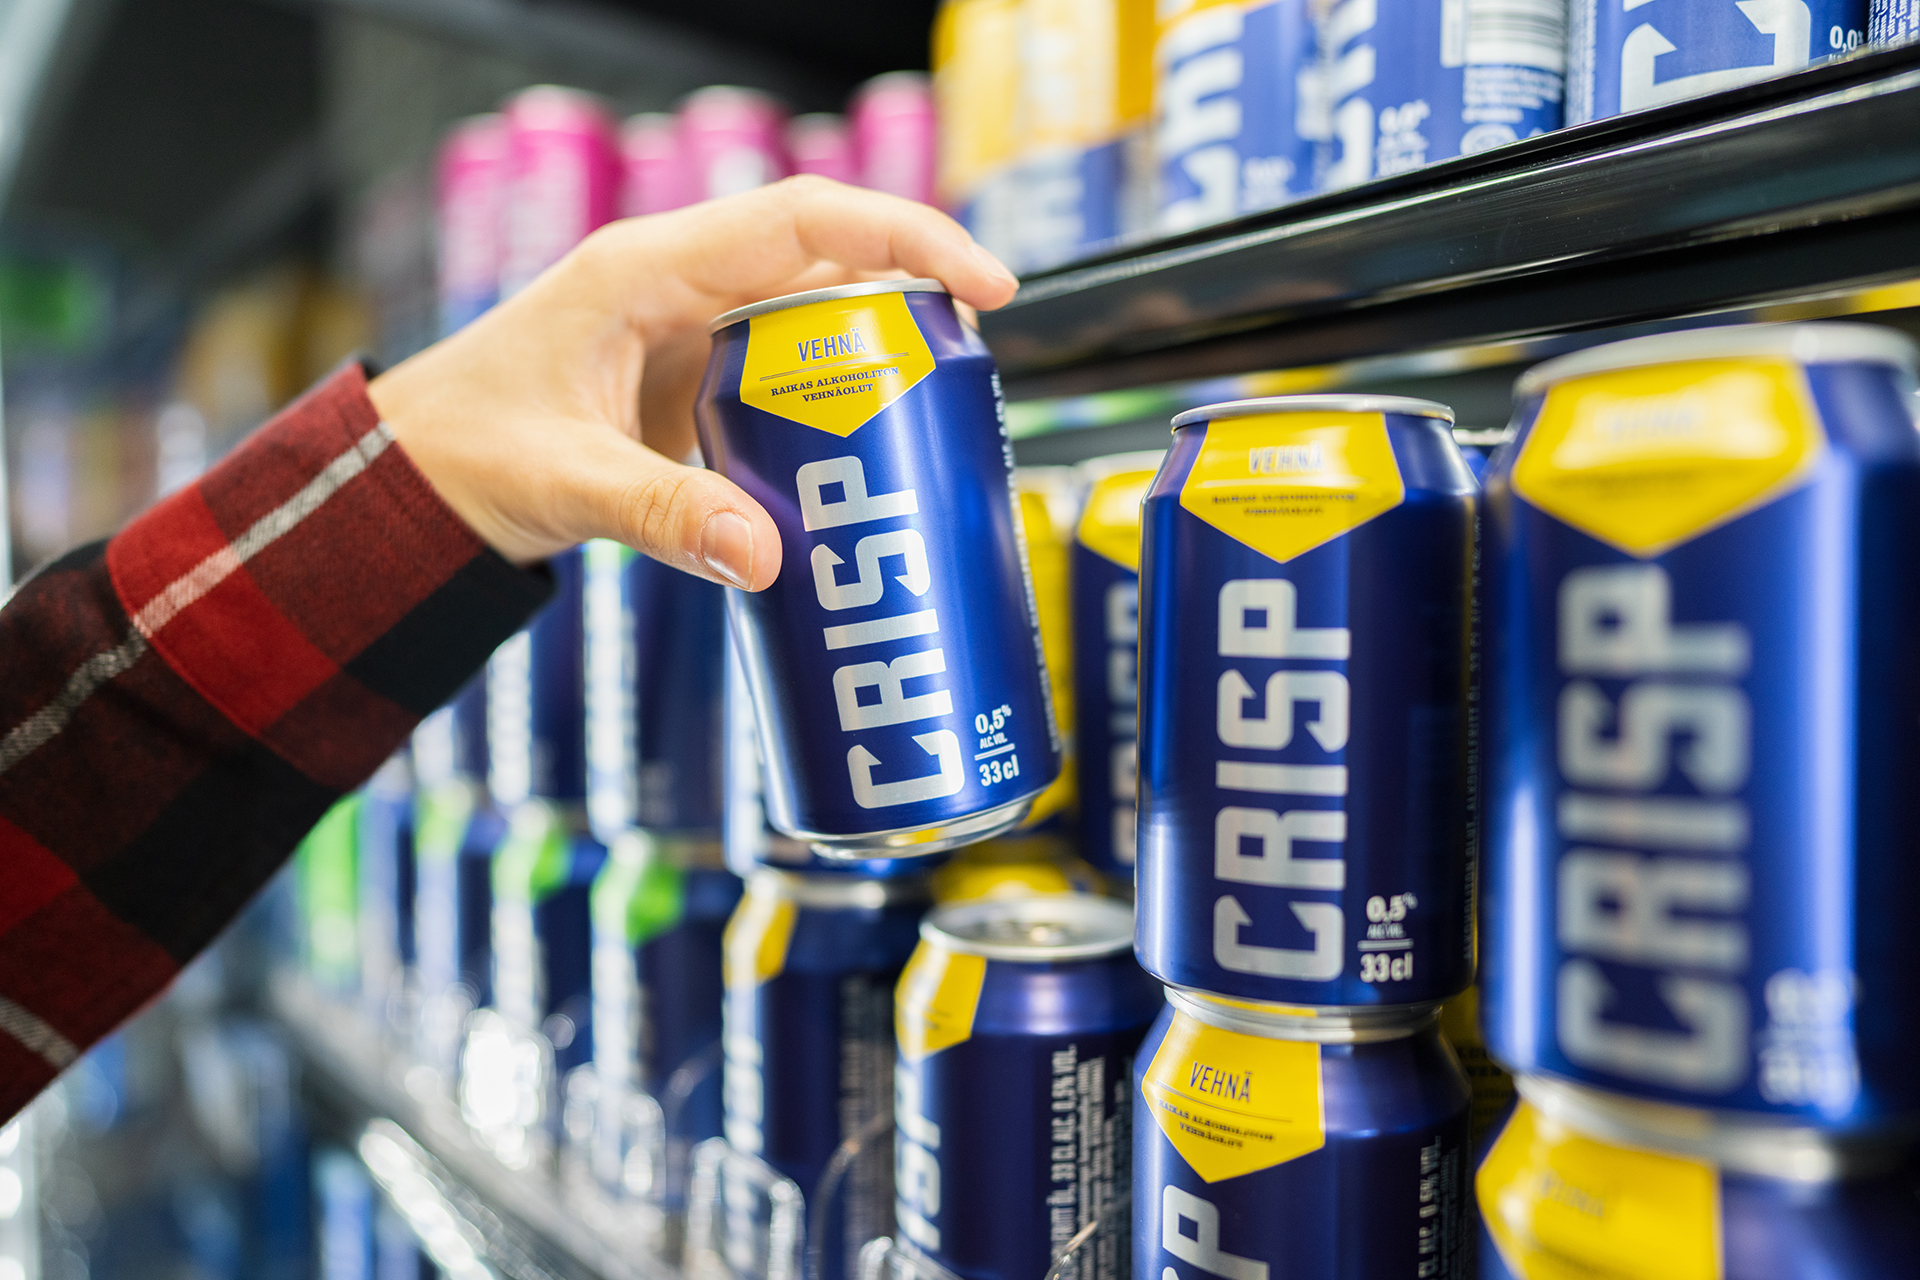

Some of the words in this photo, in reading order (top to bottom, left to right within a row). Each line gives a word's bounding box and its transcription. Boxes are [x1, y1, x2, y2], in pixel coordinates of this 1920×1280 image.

[797, 327, 867, 362] VEHNÄ
[770, 380, 813, 396] RAIKAS
[816, 366, 899, 388] ALKOHOLITON
[802, 383, 873, 402] VEHNÄOLUT
[796, 455, 965, 810] CRISP
[975, 703, 1013, 735] 0,5%
[980, 736, 995, 750] ALC.
[979, 754, 1020, 787] 33cl
[1213, 578, 1351, 983] CRISP
[1556, 563, 1752, 1096] CRISP
[1366, 892, 1418, 924] 0,5%
[1360, 951, 1413, 983] 33cl
[1189, 1061, 1252, 1103] VEHNÄ
